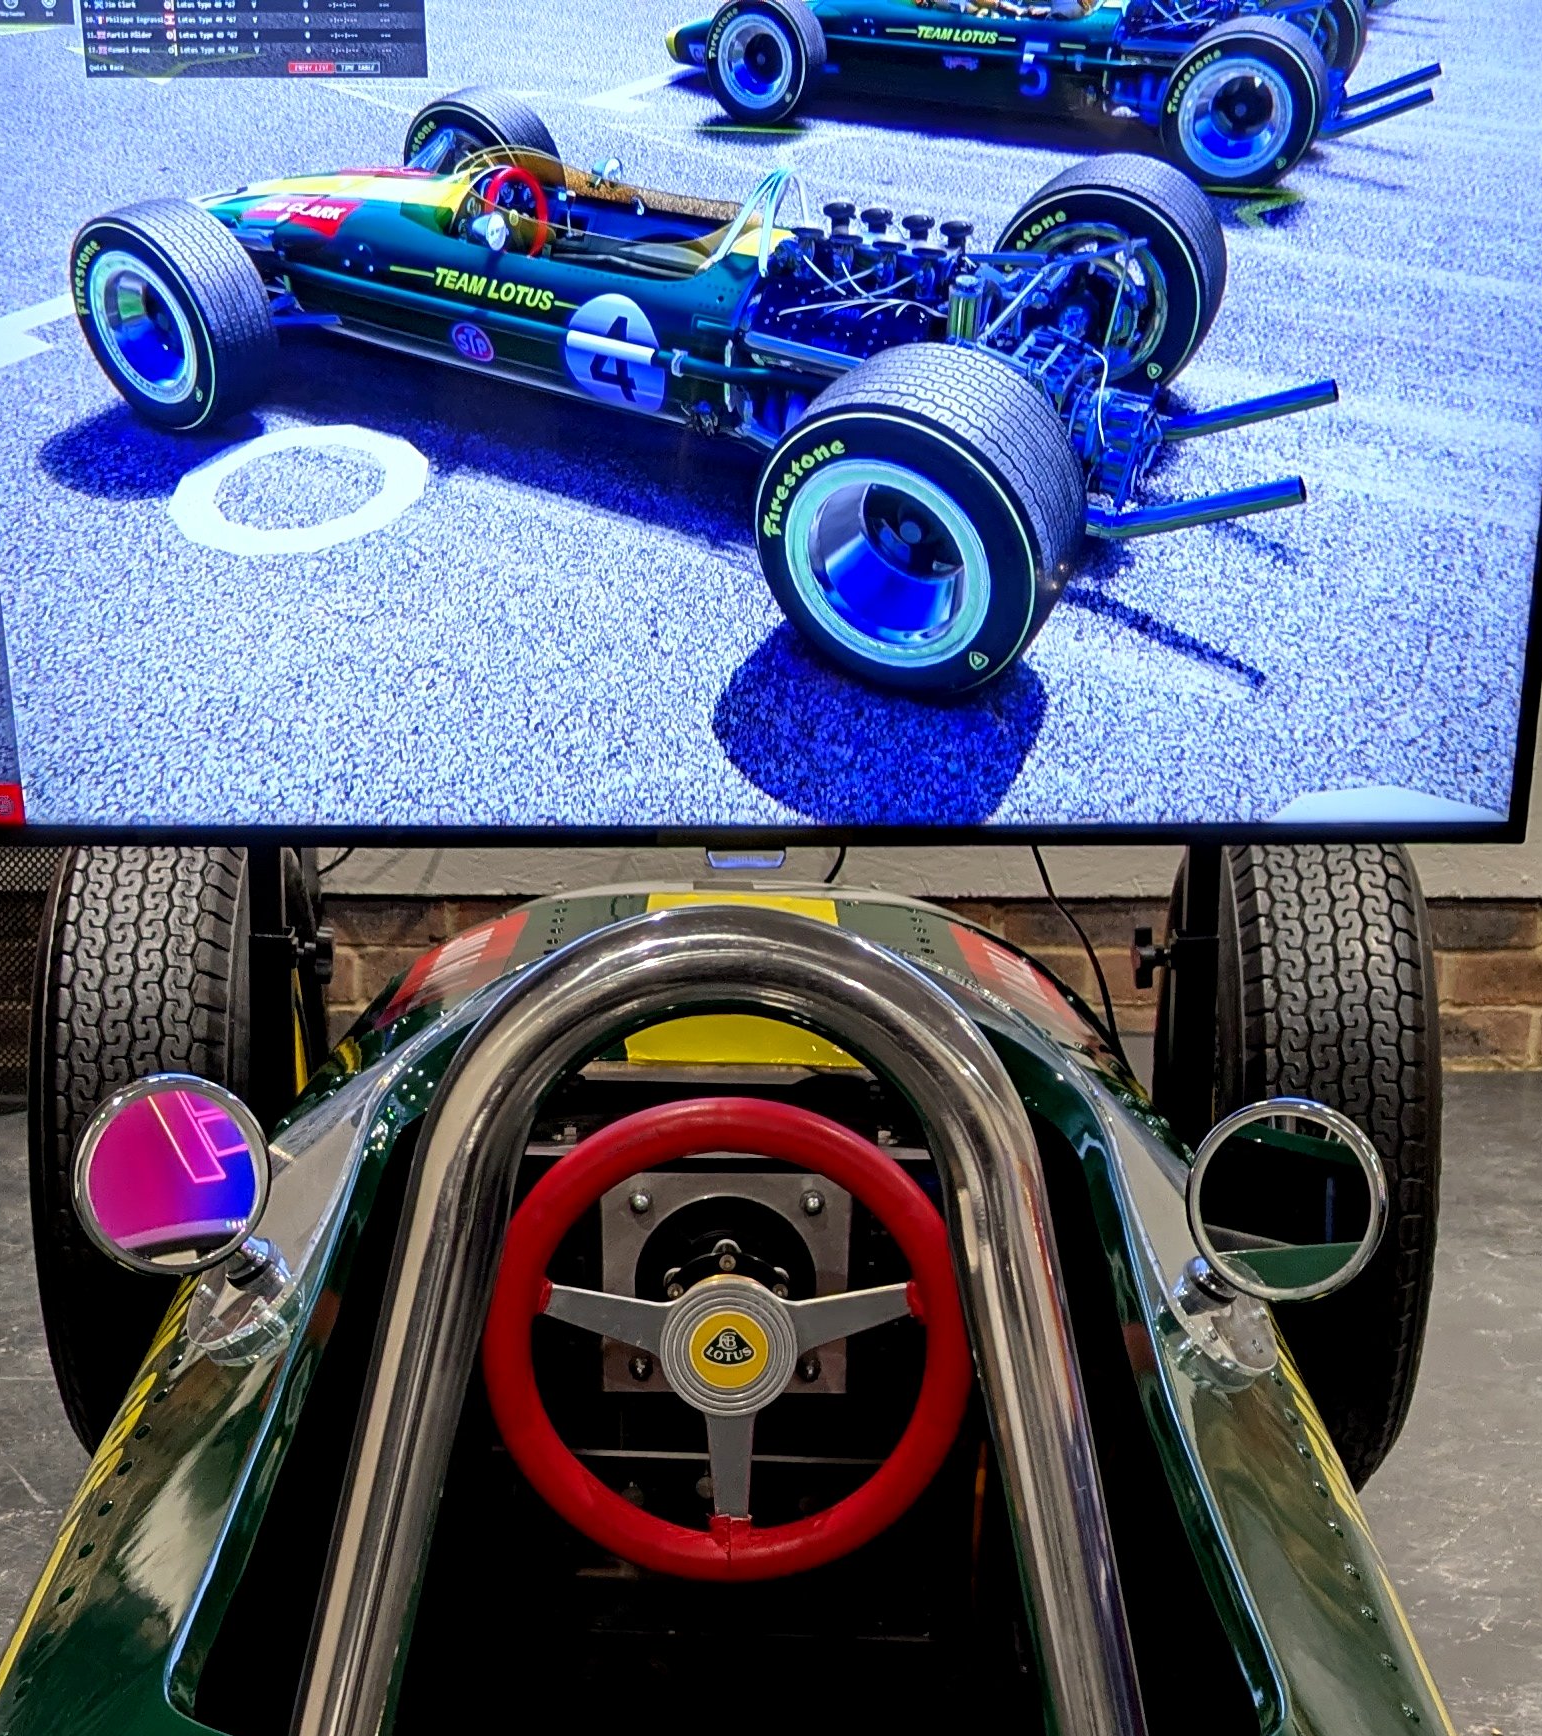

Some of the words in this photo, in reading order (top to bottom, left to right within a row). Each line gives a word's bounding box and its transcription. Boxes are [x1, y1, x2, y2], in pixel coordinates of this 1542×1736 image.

[917, 25, 953, 42] TEAM
[955, 28, 998, 44] LOTUS
[1020, 41, 1050, 97] 5
[1167, 48, 1222, 115] Firestone
[287, 203, 347, 221] CLARK
[76, 238, 102, 317] Firestone
[434, 267, 487, 297] TEAM
[491, 279, 555, 311] LOTUS
[458, 326, 487, 355] STP
[590, 316, 638, 403] 4
[762, 438, 846, 538] Firestone
[705, 1346, 754, 1363] LOTUS
